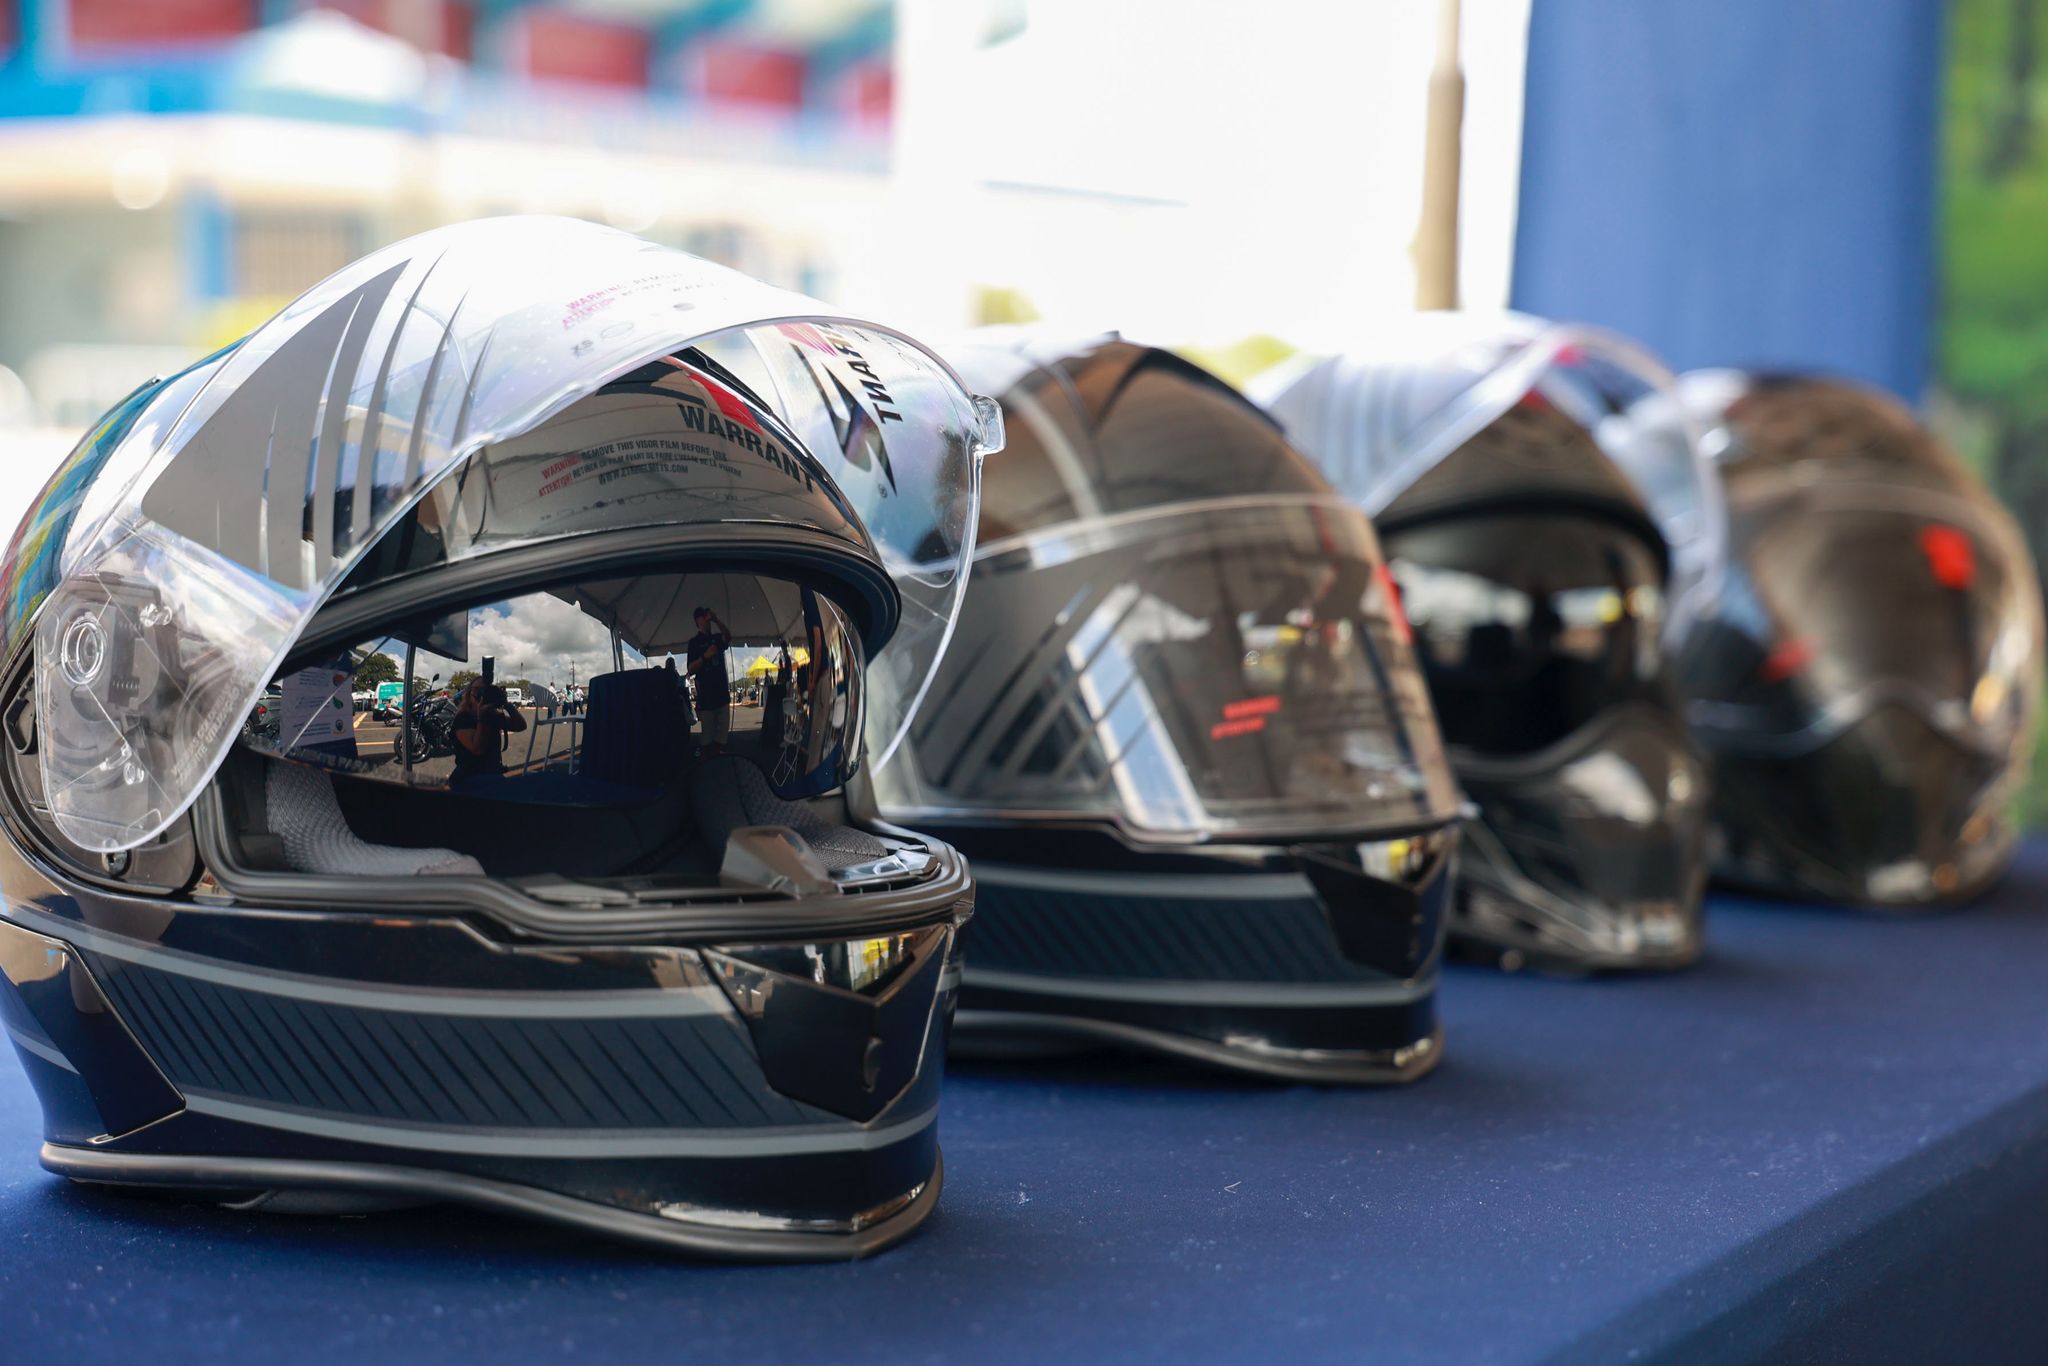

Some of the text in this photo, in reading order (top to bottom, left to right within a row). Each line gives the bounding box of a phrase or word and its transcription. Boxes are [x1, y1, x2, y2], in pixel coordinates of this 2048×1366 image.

[616, 440, 635, 451] THIS
[635, 439, 660, 450] VISOR
[660, 440, 681, 450] FILM
[680, 442, 711, 456] BEFORE
